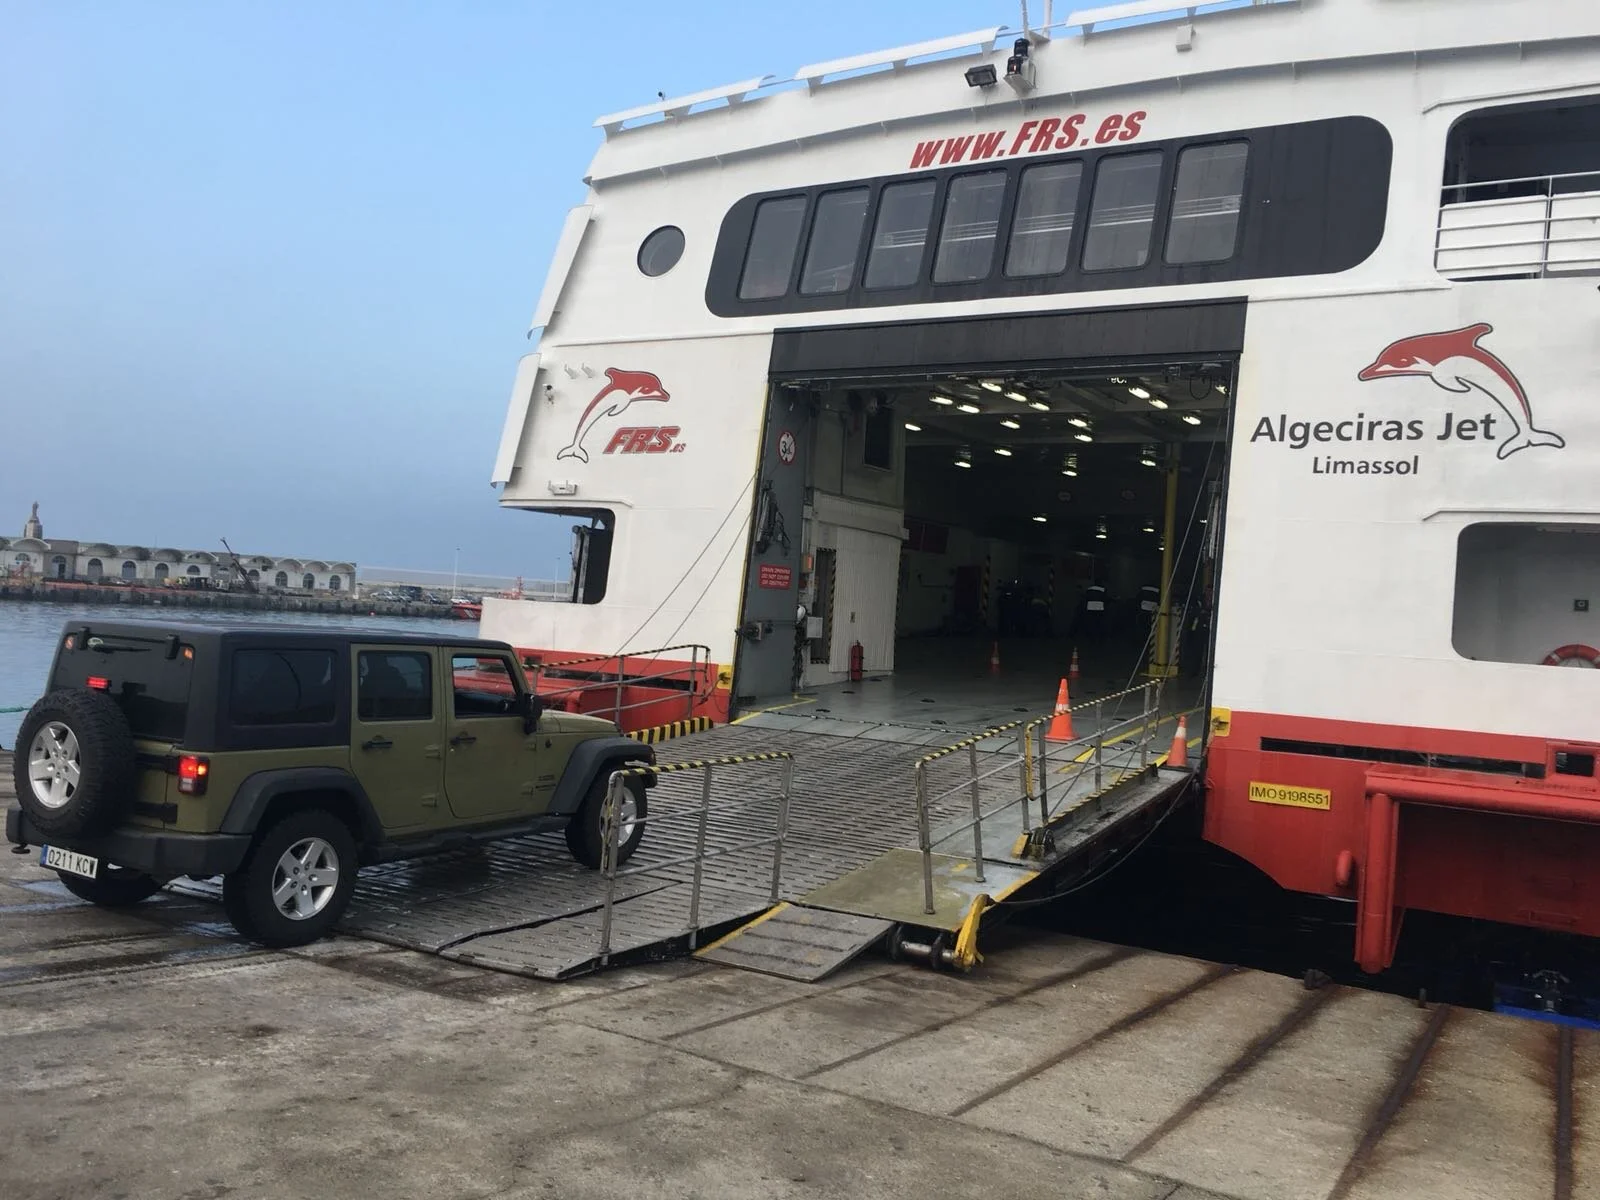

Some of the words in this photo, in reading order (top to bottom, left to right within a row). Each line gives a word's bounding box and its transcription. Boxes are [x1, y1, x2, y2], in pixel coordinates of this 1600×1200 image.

[909, 111, 1147, 169] www.FRS.es
[1250, 413, 1424, 450] Algeciras
[1436, 413, 1497, 441] Jet
[1312, 455, 1419, 475] Limassol
[1251, 786, 1277, 800] IMO
[1279, 790, 1330, 806] 9198551
[48, 849, 73, 869] 0211
